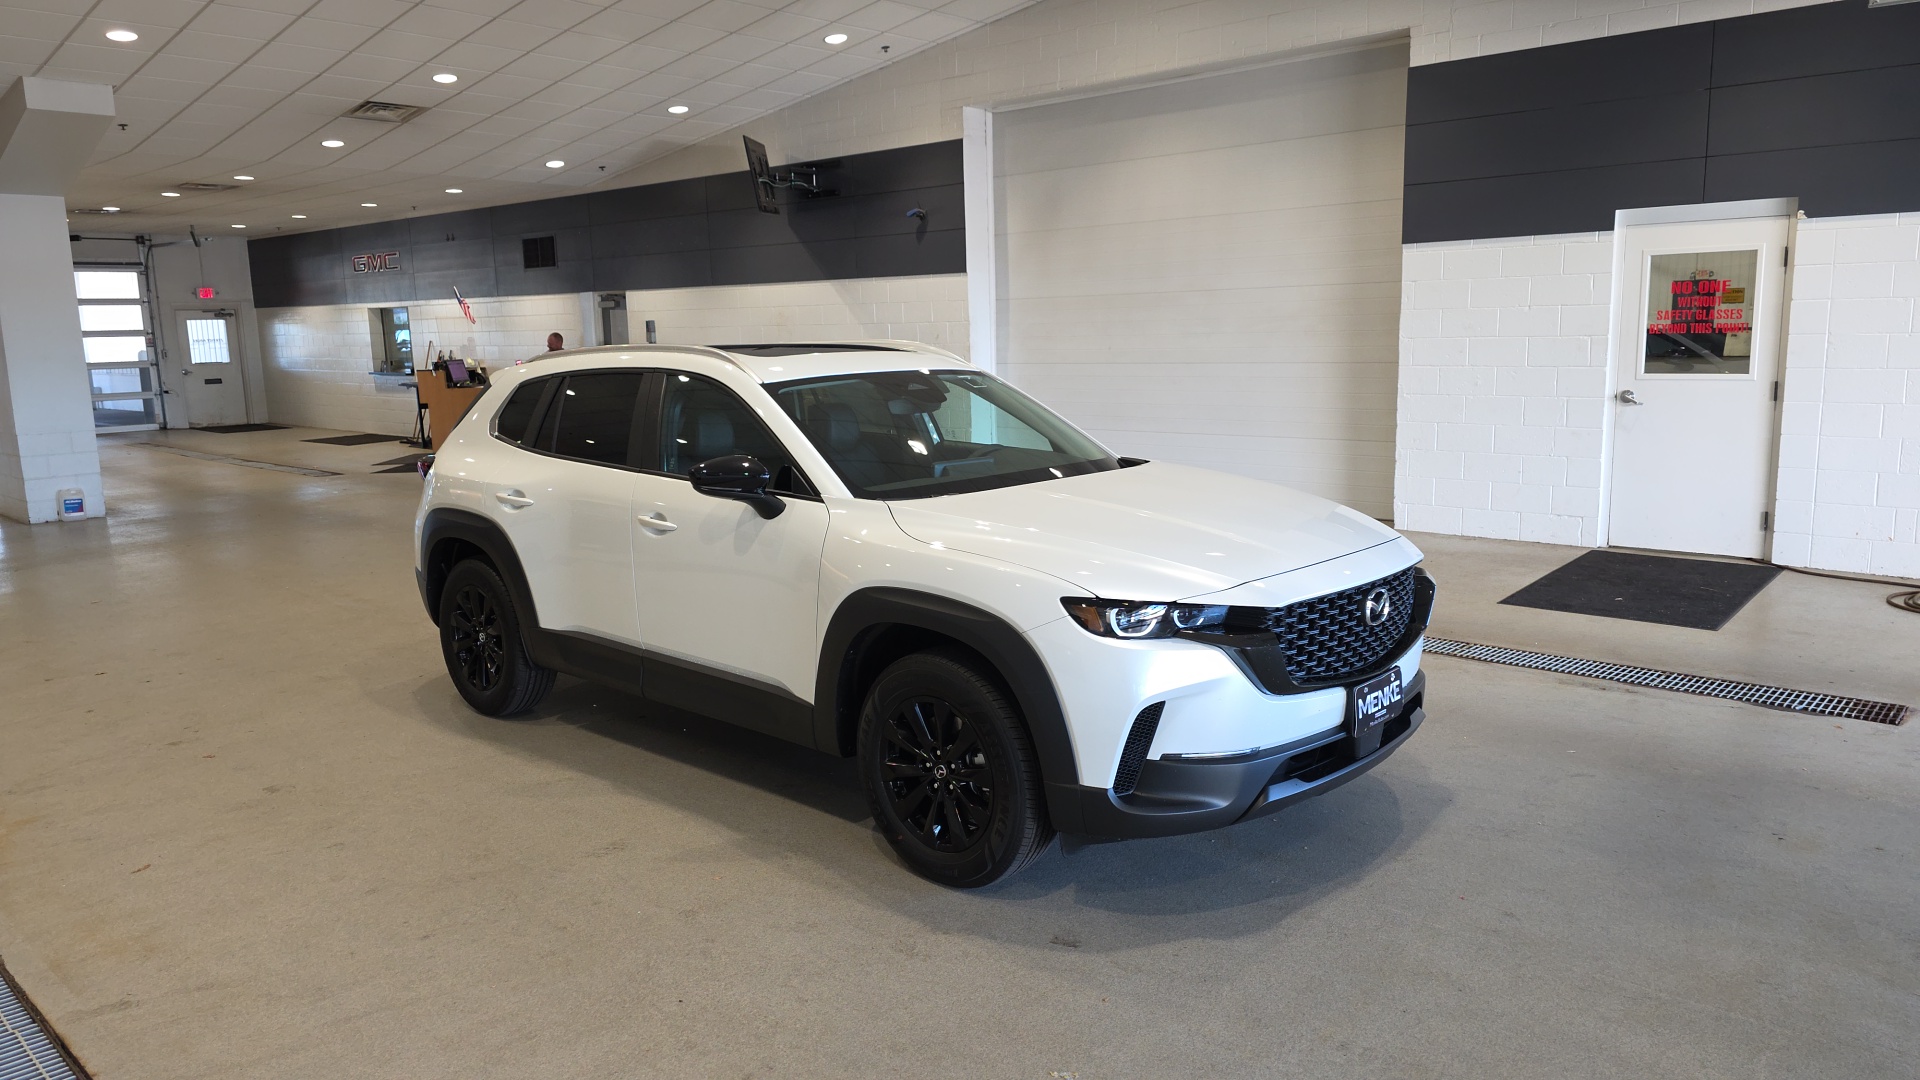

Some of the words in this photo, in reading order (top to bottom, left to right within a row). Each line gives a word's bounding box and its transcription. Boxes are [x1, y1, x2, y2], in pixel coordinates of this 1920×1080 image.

[352, 252, 400, 273] GMC
[1671, 280, 1693, 294] NO
[1698, 280, 1731, 293] ONE
[1677, 296, 1722, 307] WITHOUT
[1656, 310, 1693, 321] SAFETY
[1695, 309, 1743, 320] GLASSES
[1648, 323, 1687, 334] BEYOND
[1690, 323, 1712, 334] THIS
[1715, 322, 1749, 334] POINT!
[1358, 680, 1401, 719] MENKE
